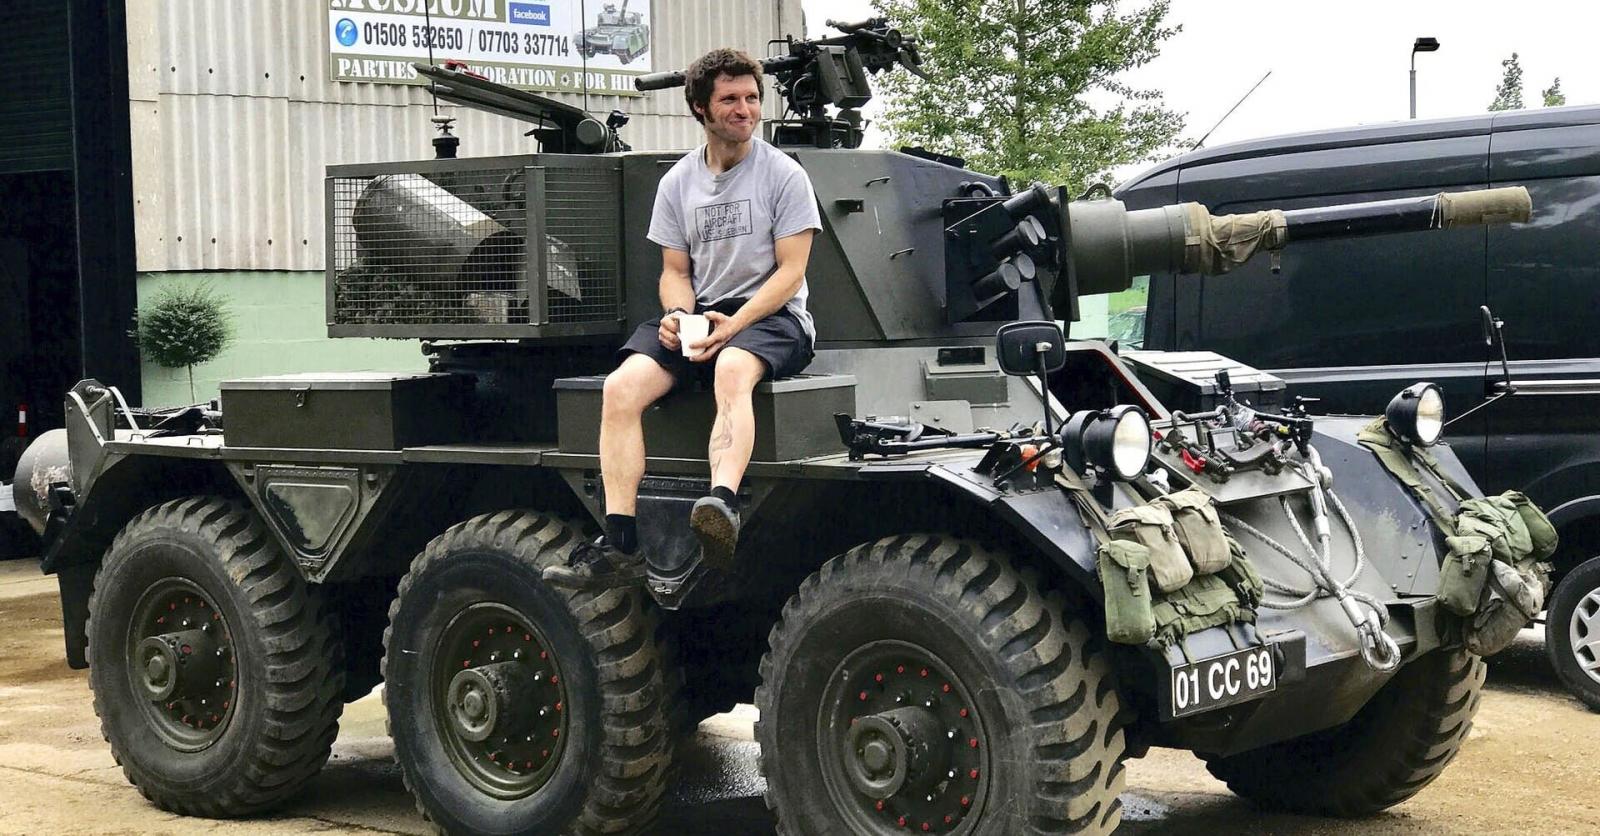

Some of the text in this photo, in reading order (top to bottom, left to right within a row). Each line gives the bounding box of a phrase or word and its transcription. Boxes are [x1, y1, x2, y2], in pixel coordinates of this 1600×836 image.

[513, 8, 547, 20] facebook
[364, 22, 407, 47] 01508
[412, 25, 463, 50] 532650
[479, 29, 519, 54] 07703
[524, 33, 569, 57] 337714
[337, 58, 418, 80] PARTIES
[438, 63, 556, 87] TORATION
[574, 72, 606, 90] FOR
[704, 203, 740, 218] NOT FOR
[1175, 650, 1272, 709] 01 CC 69
